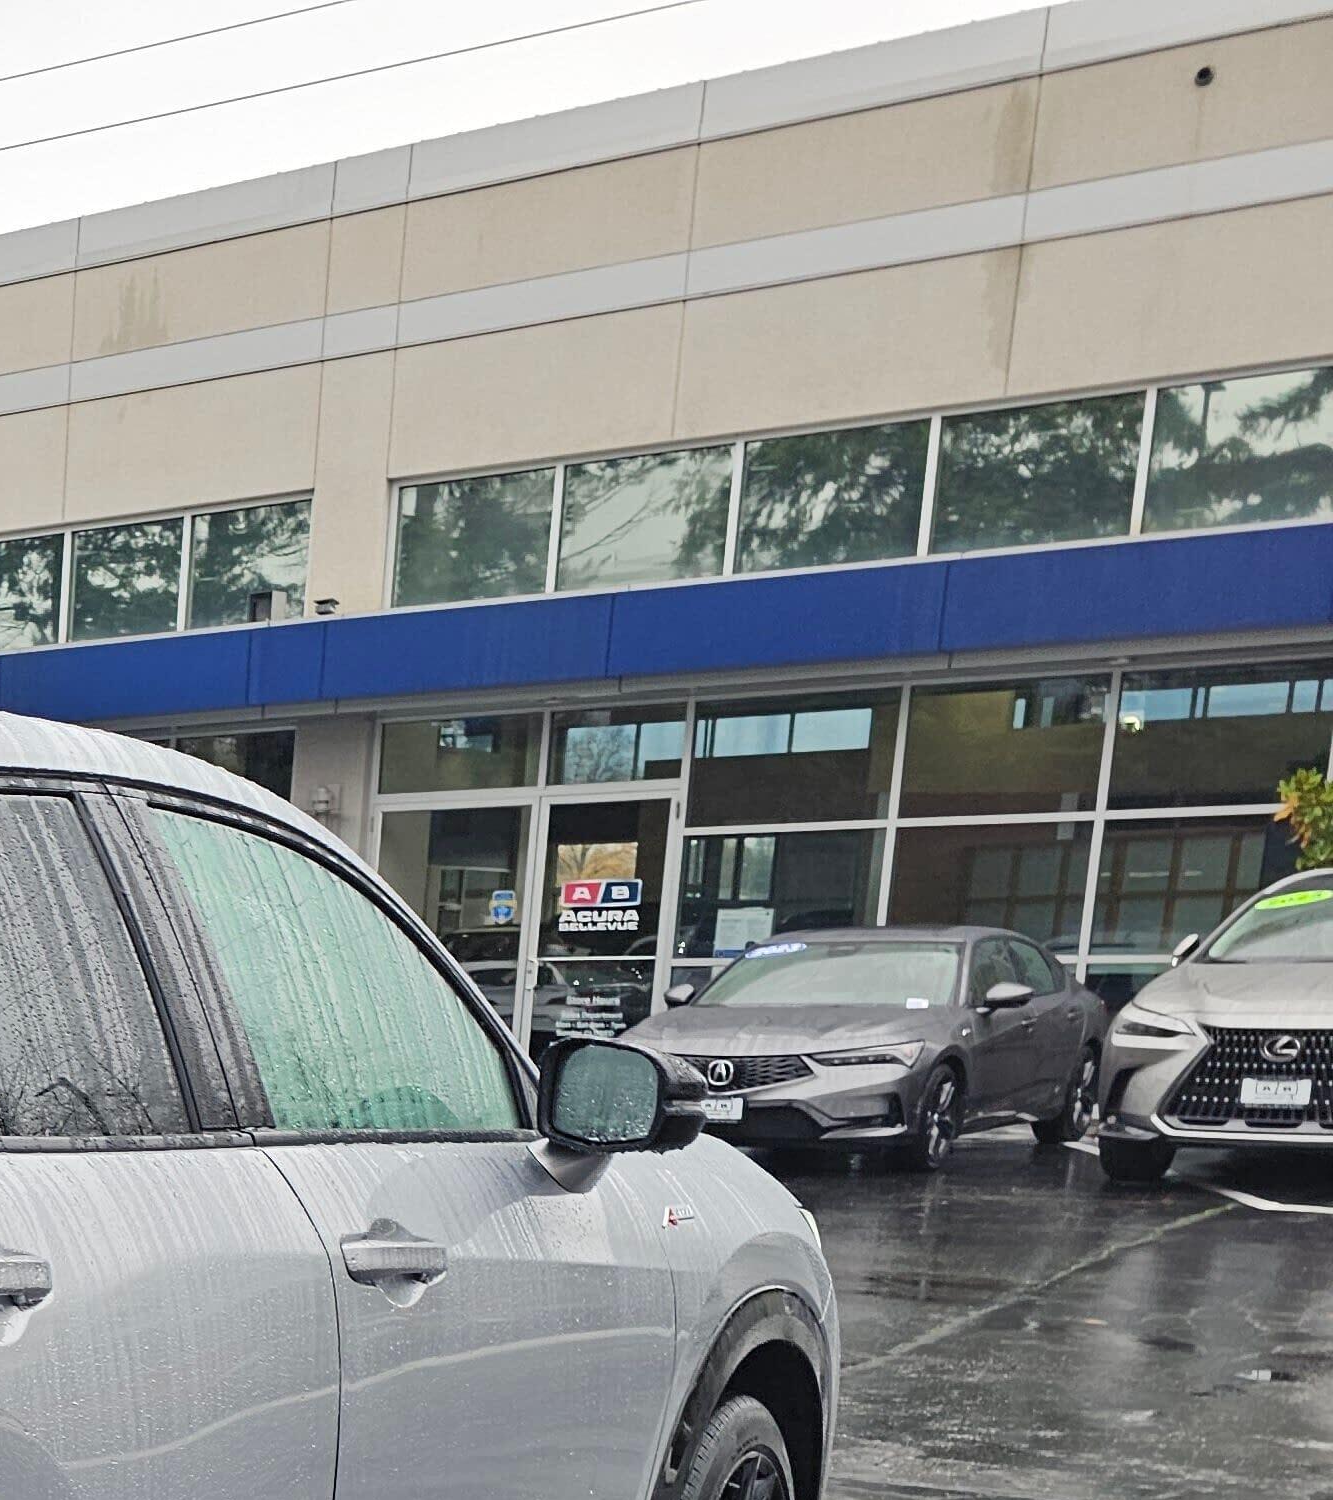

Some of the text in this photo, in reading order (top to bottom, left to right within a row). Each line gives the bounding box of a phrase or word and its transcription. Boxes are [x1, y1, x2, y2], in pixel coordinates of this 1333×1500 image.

[571, 885, 630, 901] A B
[558, 909, 640, 923] ACURA
[558, 921, 639, 932] BELLEVUE
